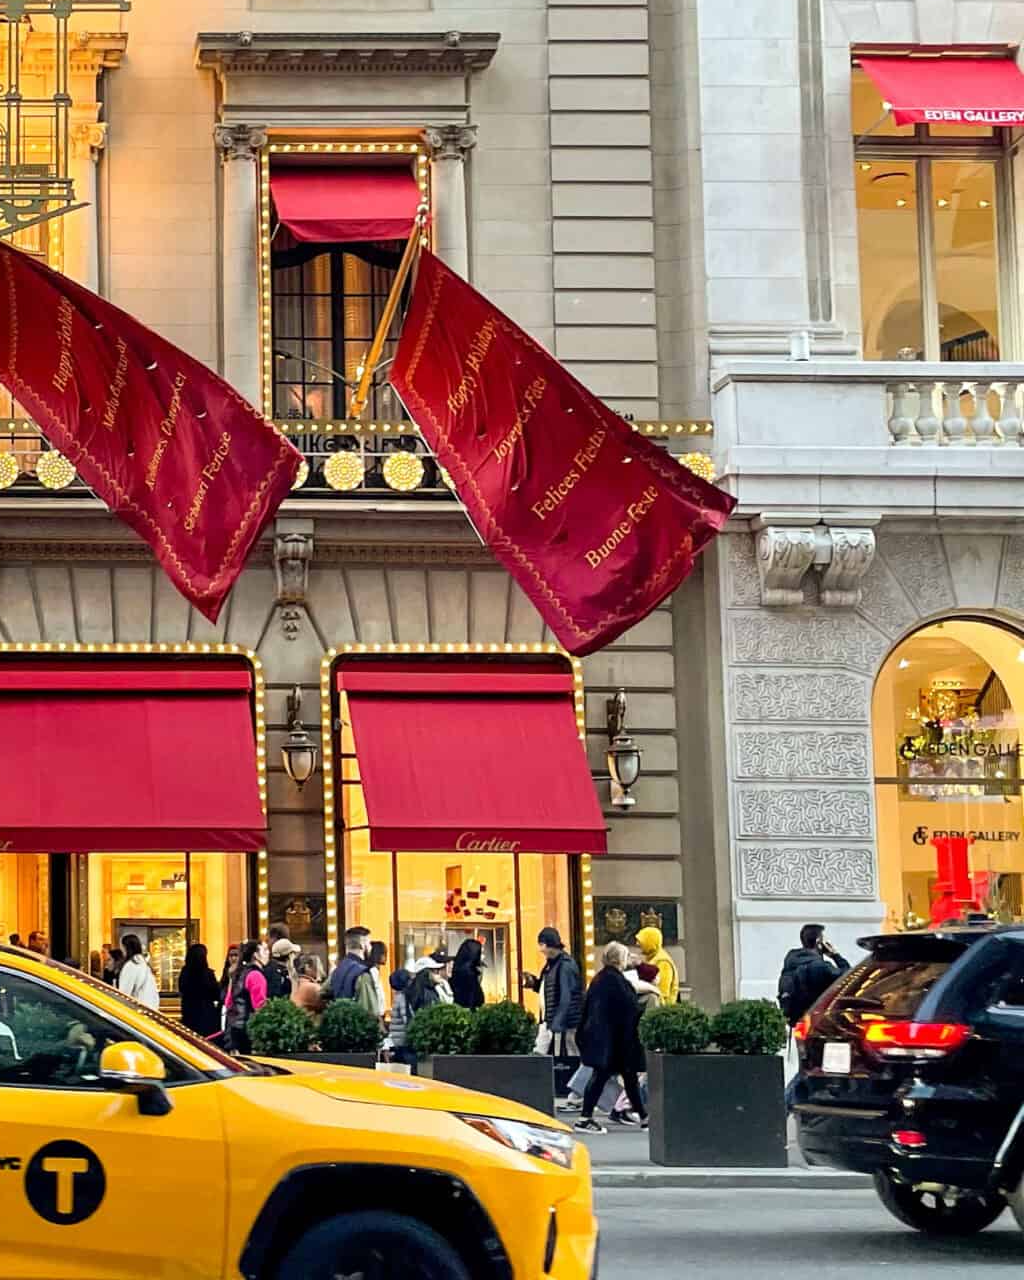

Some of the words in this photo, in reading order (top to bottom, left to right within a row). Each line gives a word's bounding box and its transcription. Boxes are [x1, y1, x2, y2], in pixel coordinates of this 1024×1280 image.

[924, 110, 962, 121] EDEN
[963, 110, 1024, 122] GALLERY
[51, 345, 75, 393] Happy
[446, 369, 478, 416] Happy
[530, 469, 581, 521] Felices
[583, 519, 632, 569] Buone
[625, 483, 660, 526] Feste
[928, 743, 970, 757] EDEN
[456, 831, 521, 851] Cartier
[967, 830, 1021, 841] GALLERY
[42, 1157, 89, 1214] T
